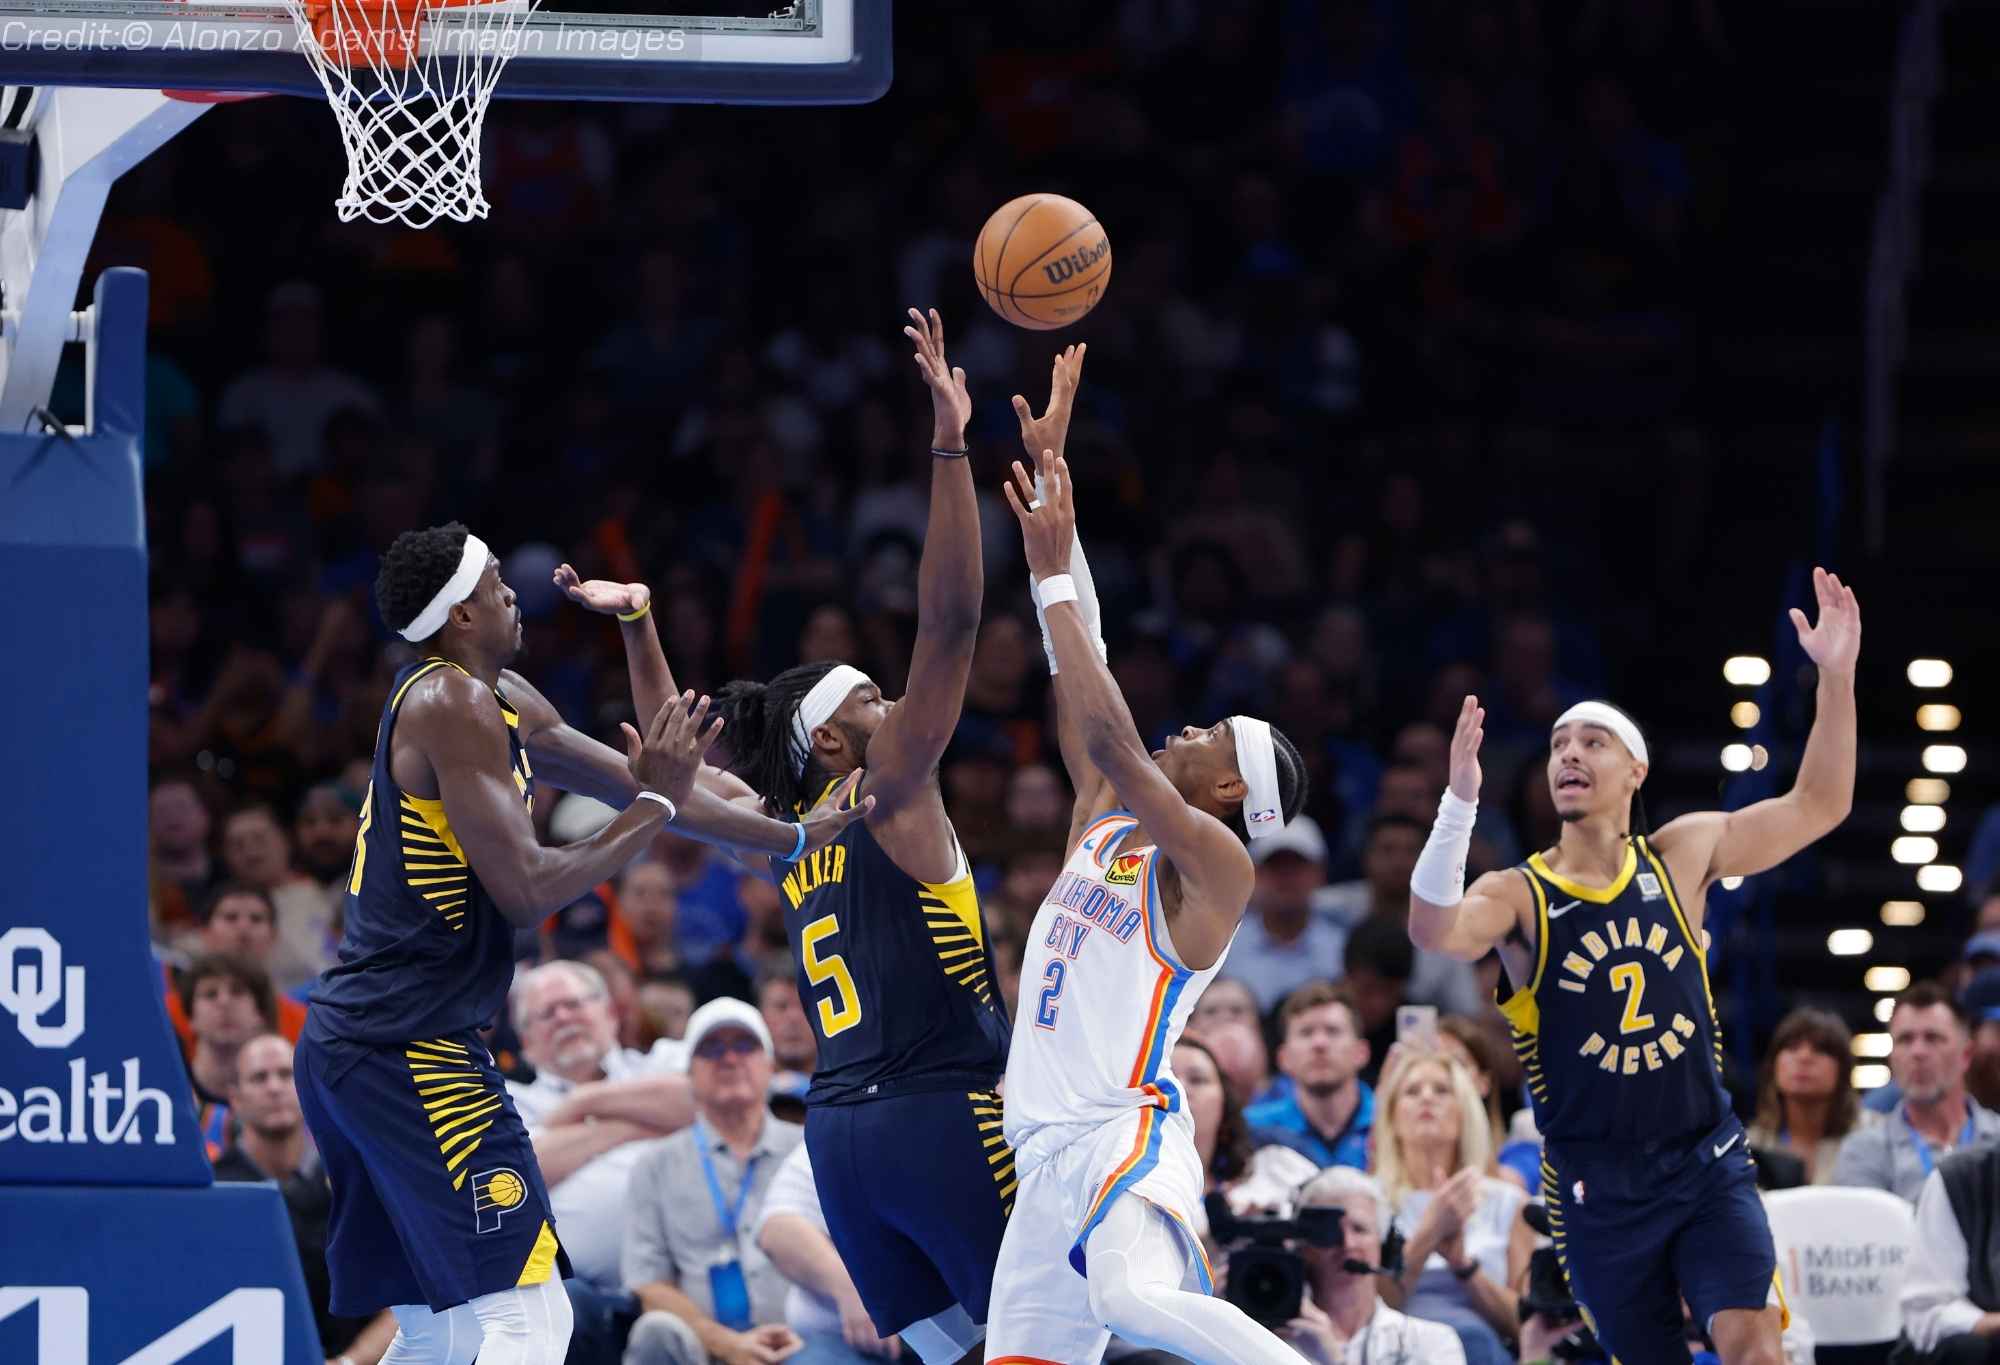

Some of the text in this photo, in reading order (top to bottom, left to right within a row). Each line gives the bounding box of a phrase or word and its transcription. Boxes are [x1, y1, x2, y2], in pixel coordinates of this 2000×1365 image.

[781, 844, 847, 911] WLKER
[801, 912, 862, 1039] 5
[1558, 916, 1685, 993] INDIANA
[1035, 957, 1068, 1031] 2
[1609, 960, 1656, 1036] 2
[1578, 1012, 1696, 1075] PACERS
